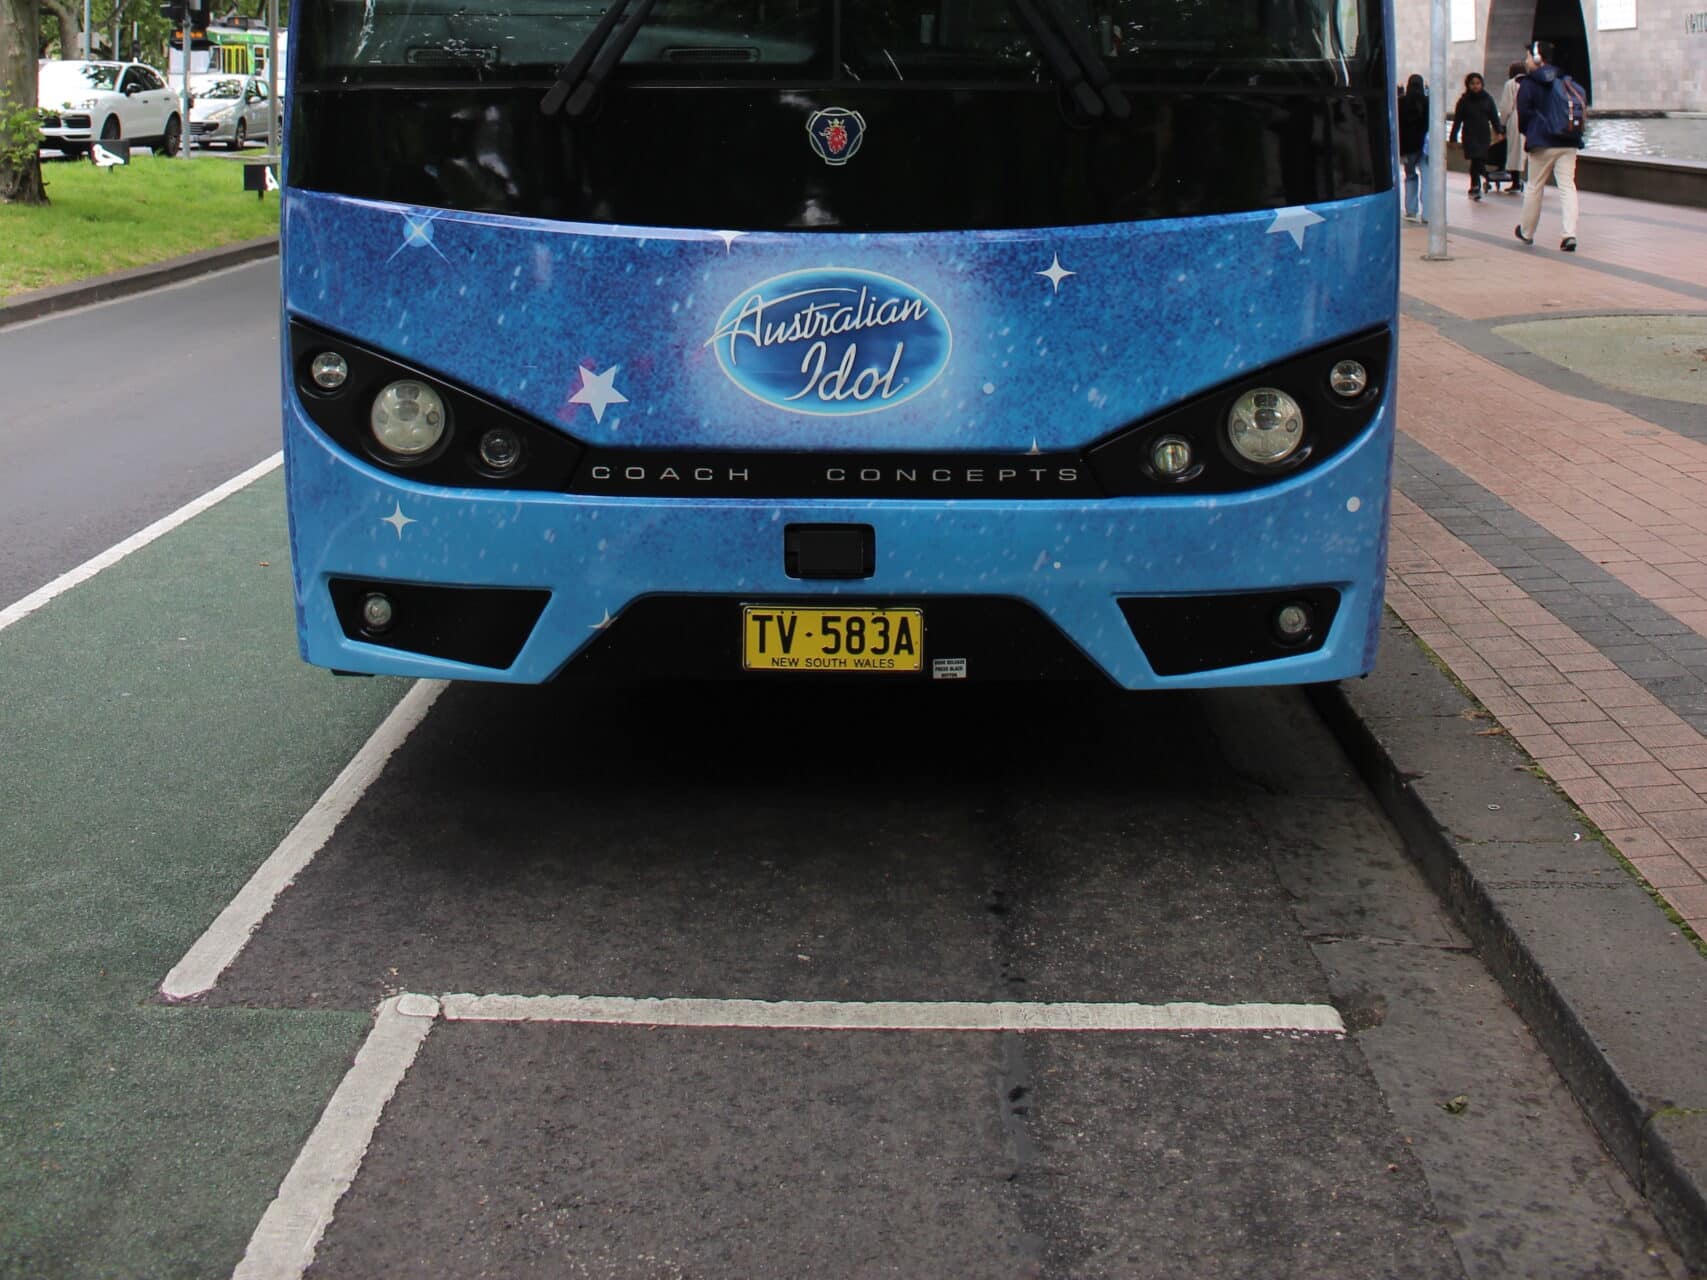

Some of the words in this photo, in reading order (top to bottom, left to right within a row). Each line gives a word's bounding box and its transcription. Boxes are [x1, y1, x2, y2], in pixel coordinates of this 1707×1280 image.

[704, 285, 928, 365] Australian
[784, 341, 904, 401] Idol
[592, 466, 748, 481] COACH
[826, 468, 1078, 482] CONCEPTS
[771, 657, 799, 667] NEW
[805, 658, 847, 668] SOUTH
[853, 658, 895, 669] WALES
